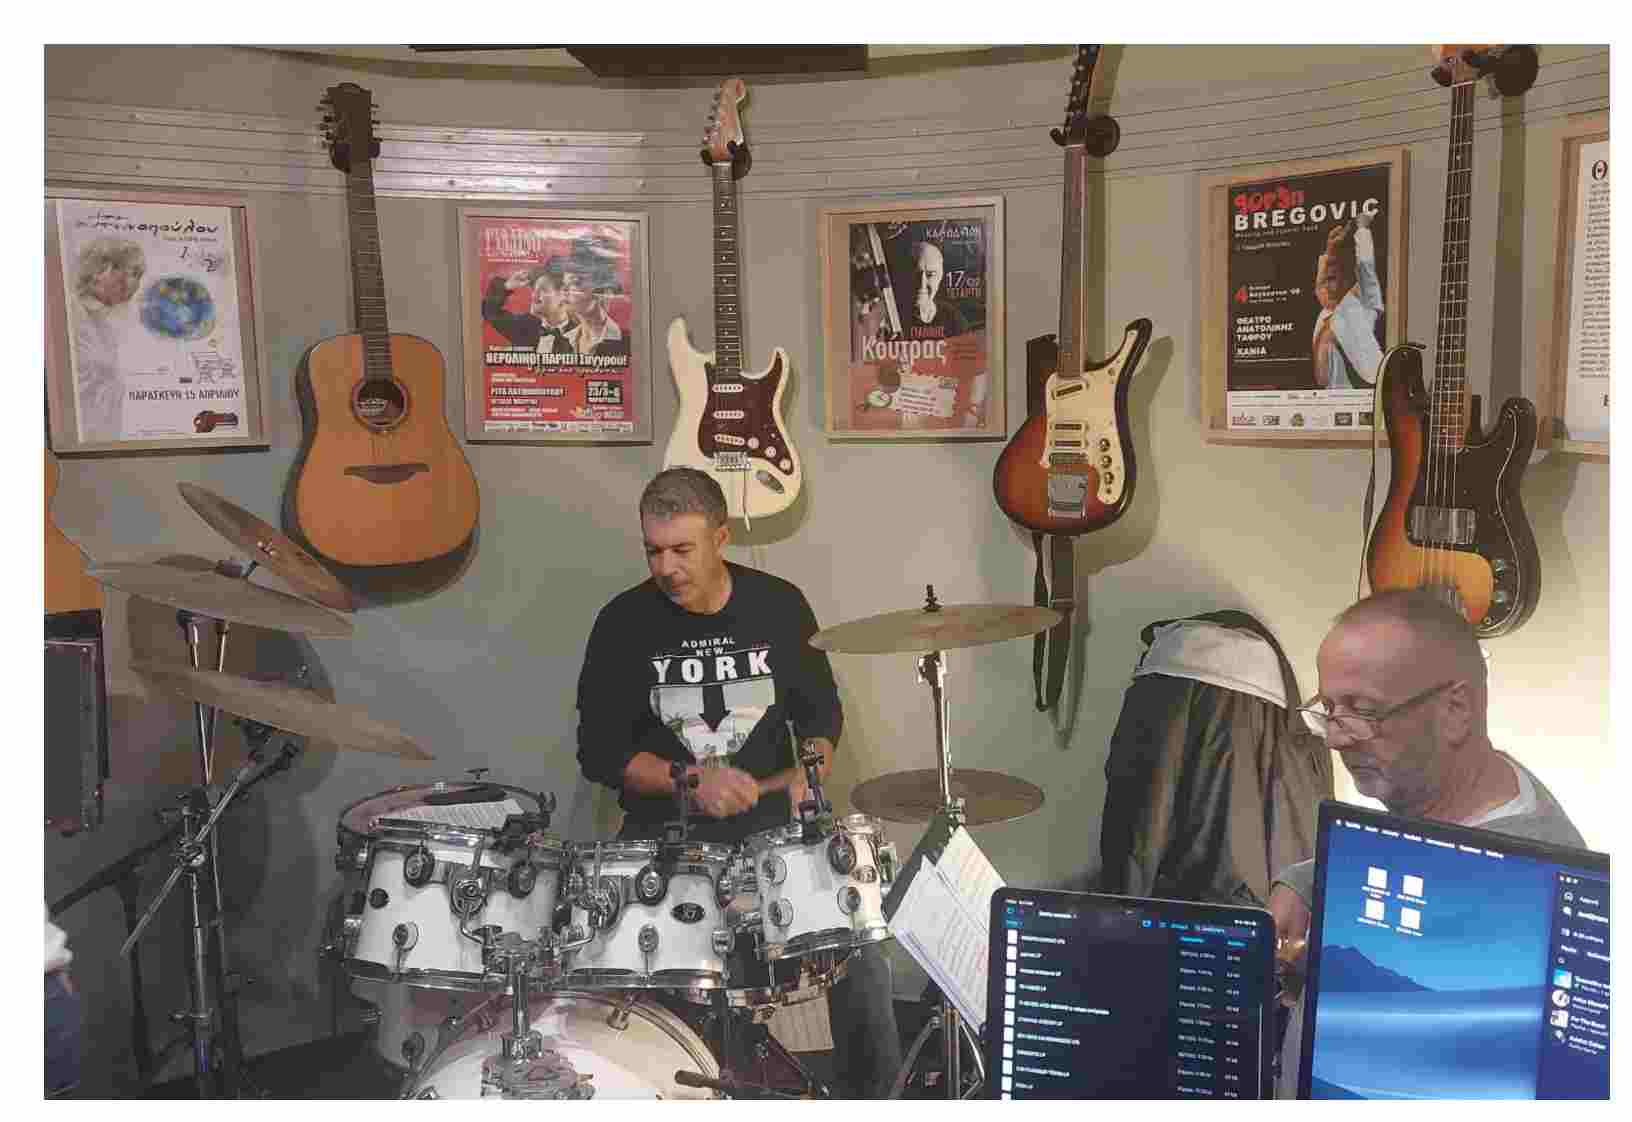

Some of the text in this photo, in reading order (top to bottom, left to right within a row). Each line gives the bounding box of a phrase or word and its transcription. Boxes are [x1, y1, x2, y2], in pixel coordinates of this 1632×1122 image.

[1234, 197, 1380, 232] BREGOVIC
[680, 636, 736, 648] ADMIRAL
[695, 646, 724, 657] NEW
[652, 649, 772, 684] YORK
